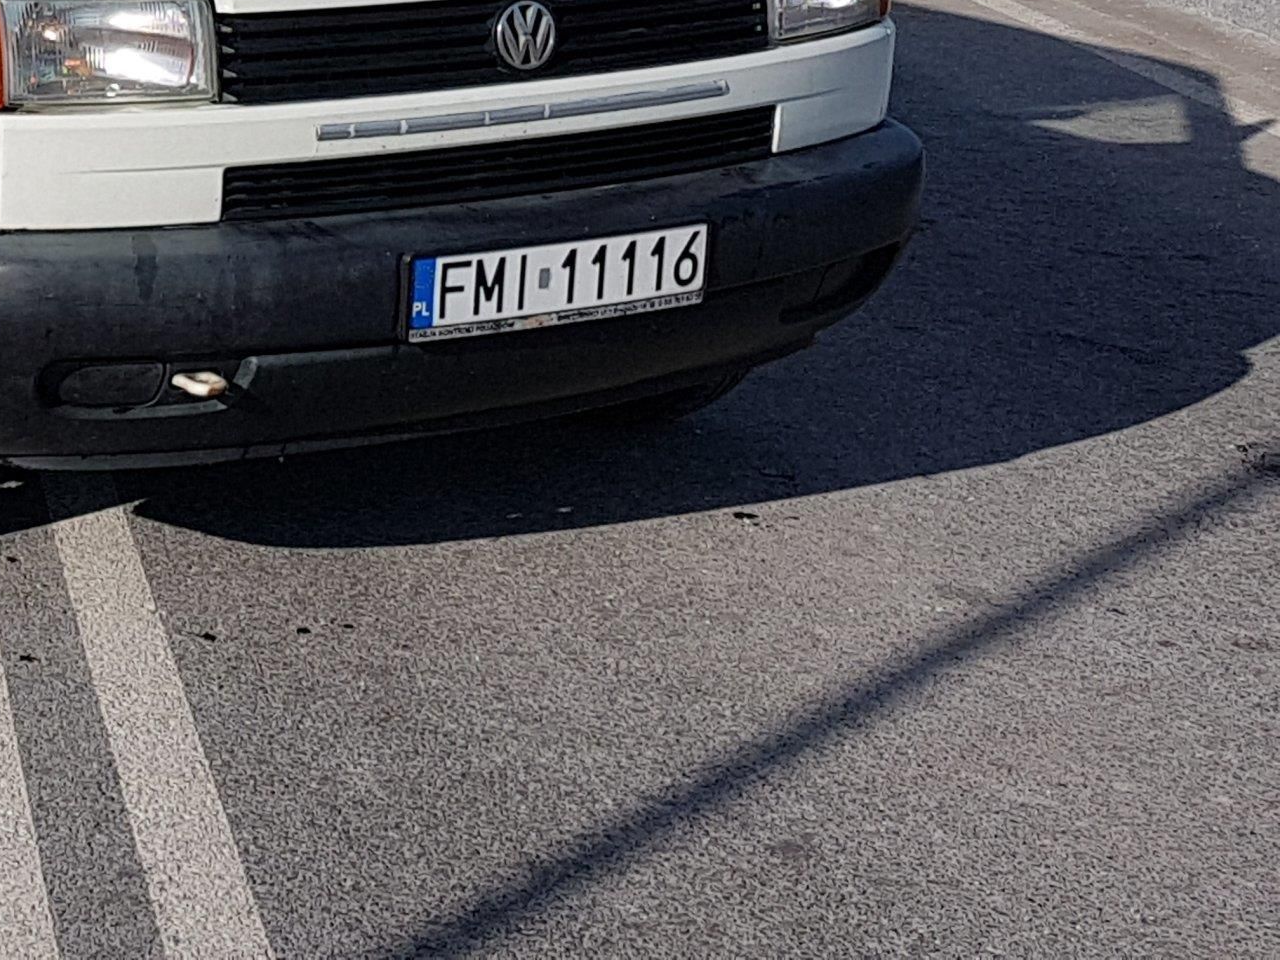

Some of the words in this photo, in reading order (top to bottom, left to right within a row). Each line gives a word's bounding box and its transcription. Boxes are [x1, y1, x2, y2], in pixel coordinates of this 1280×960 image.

[412, 302, 430, 318] PL
[438, 254, 528, 320] FMI
[560, 230, 701, 304] 11116
